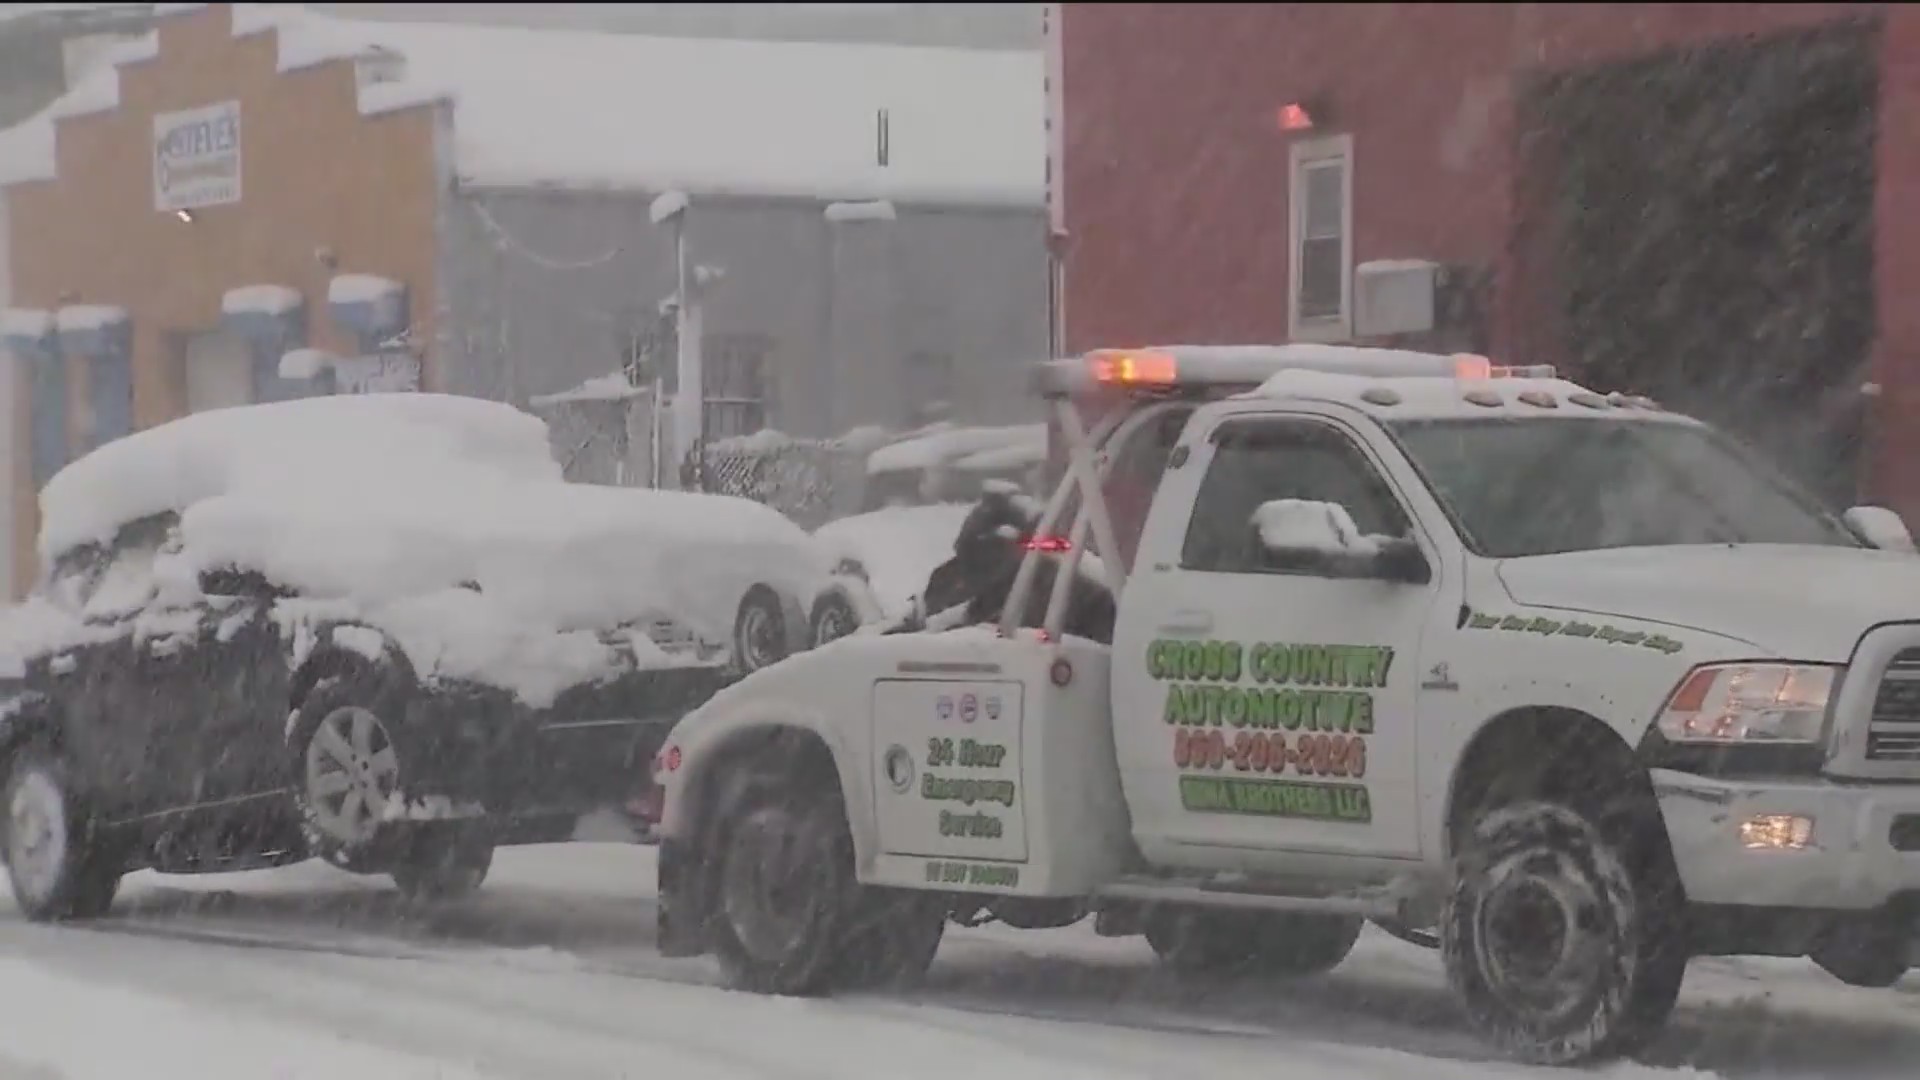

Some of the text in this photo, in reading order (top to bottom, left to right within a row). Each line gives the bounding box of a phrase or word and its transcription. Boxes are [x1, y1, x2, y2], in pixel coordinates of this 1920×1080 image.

[1527, 616, 1561, 636] Stop
[1642, 634, 1684, 655] Shop
[1147, 640, 1395, 687] CROSS COUNTRY
[1164, 683, 1374, 734] AUTOMOTIVE
[926, 737, 1006, 768] 24 Hour
[921, 772, 1015, 807] Emergency
[939, 809, 1003, 838] Service
